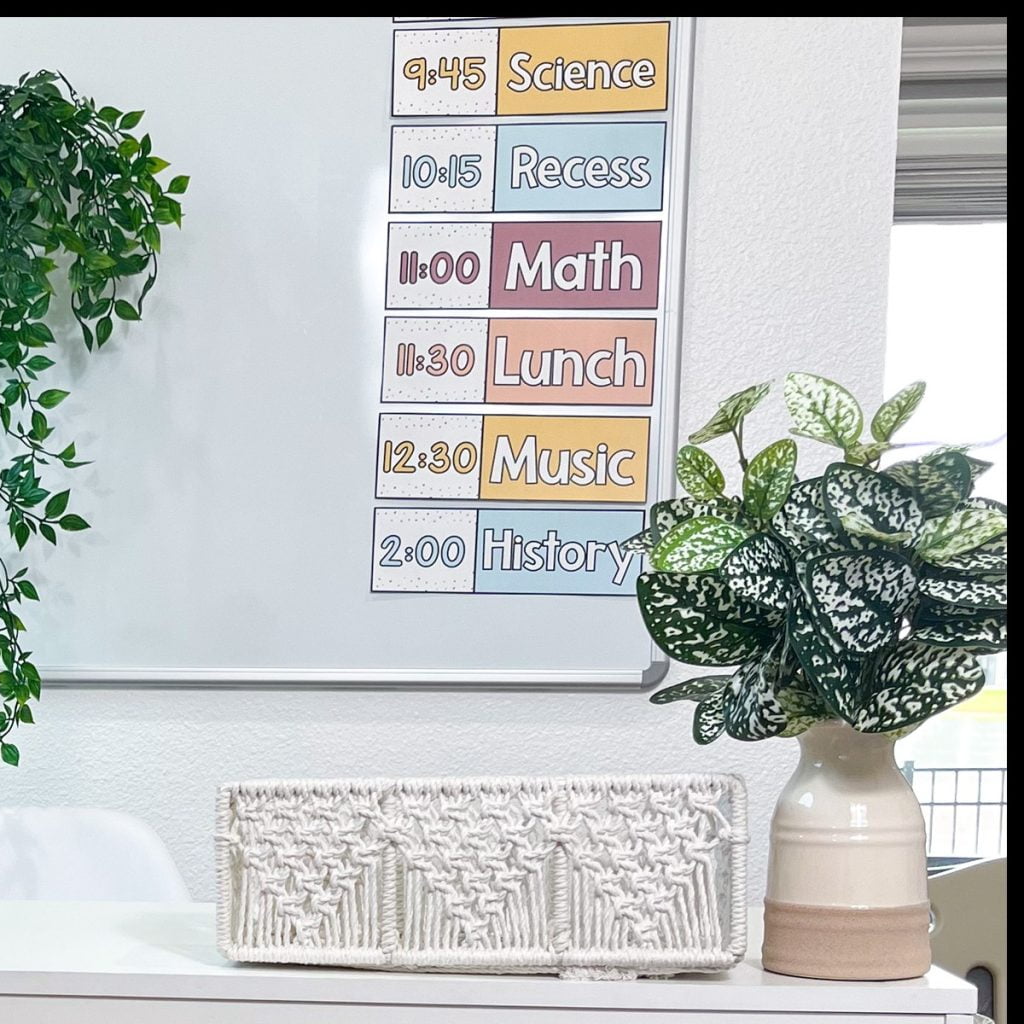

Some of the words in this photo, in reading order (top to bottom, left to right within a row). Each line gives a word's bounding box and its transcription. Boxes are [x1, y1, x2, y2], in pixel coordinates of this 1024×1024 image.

[403, 56, 486, 91] 9:45
[507, 52, 656, 93] Science
[402, 154, 481, 189] 10:15
[511, 145, 651, 189] Recess
[399, 251, 480, 285] 11:00
[504, 240, 643, 291] Math
[396, 343, 475, 377] 11:30
[493, 336, 646, 387] Lunch
[383, 440, 477, 474] 12:30
[489, 435, 635, 486] Music
[379, 535, 466, 568] 2:00
[482, 528, 634, 586] History
